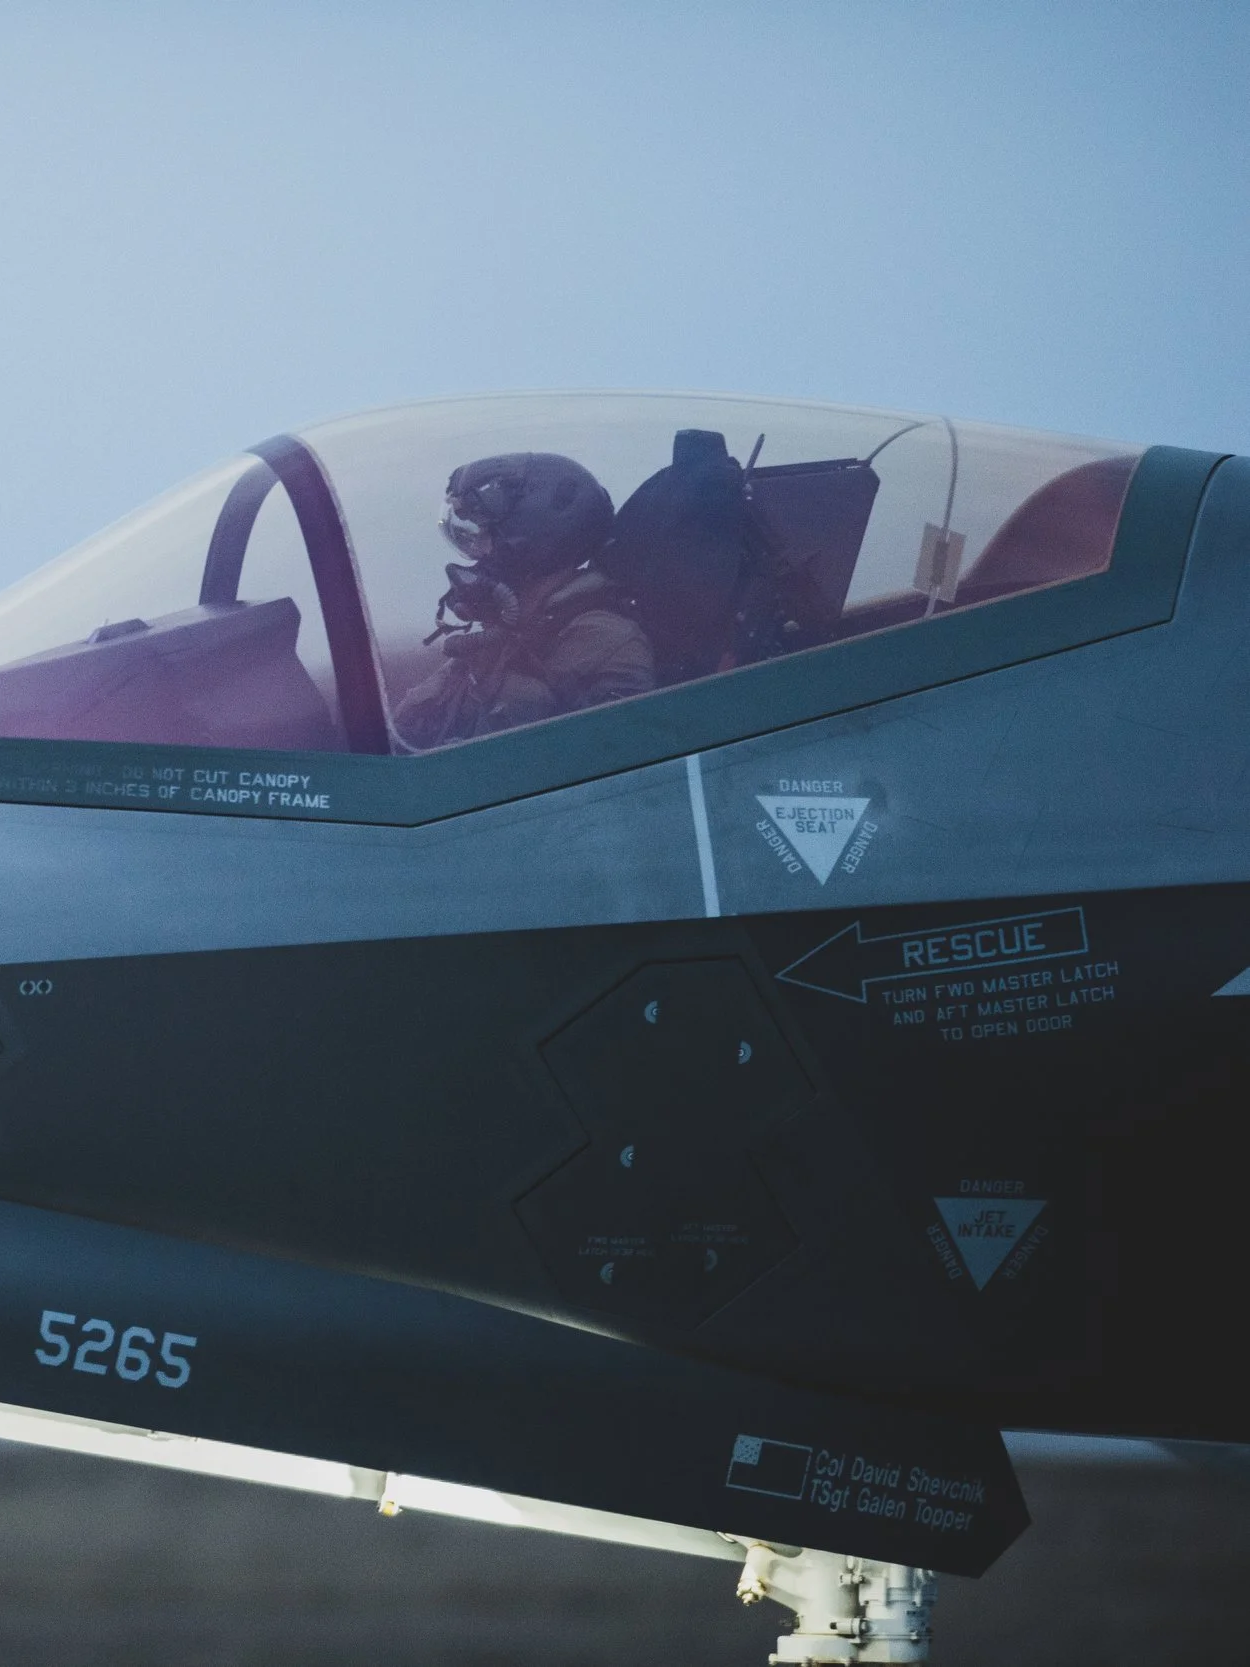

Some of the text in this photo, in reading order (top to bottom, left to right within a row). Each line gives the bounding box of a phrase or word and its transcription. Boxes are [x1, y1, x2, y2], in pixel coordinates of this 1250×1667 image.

[86, 781, 150, 799] INCHES
[158, 785, 181, 799] OF
[190, 787, 262, 804] CANOPY
[268, 791, 331, 809] FRAME
[152, 767, 185, 782] NOT
[193, 769, 230, 785] CUT
[239, 772, 311, 789] CANOPY
[779, 779, 844, 793] DANGER
[775, 806, 855, 821] EJECTION
[795, 821, 838, 834] SEAT
[755, 818, 803, 874] DANGER
[841, 820, 878, 874] DANGER
[902, 922, 1046, 969] RESCUE
[881, 961, 1120, 1006] TURN FWD MASTER LATCH
[893, 985, 1115, 1026] AND AFT MASTER LATCH
[938, 1014, 1074, 1042] TO OPEN DOOR
[959, 1179, 1026, 1194] DANGER
[956, 1223, 1017, 1238] INTAKE
[974, 1210, 1008, 1224] JET
[926, 1221, 964, 1280] DANGER
[1001, 1224, 1050, 1280] DANGER
[34, 1310, 197, 1389] 5265
[815, 1449, 846, 1479] Col
[850, 1456, 902, 1489] David
[810, 1478, 974, 1533] TSgt Galen Topper
